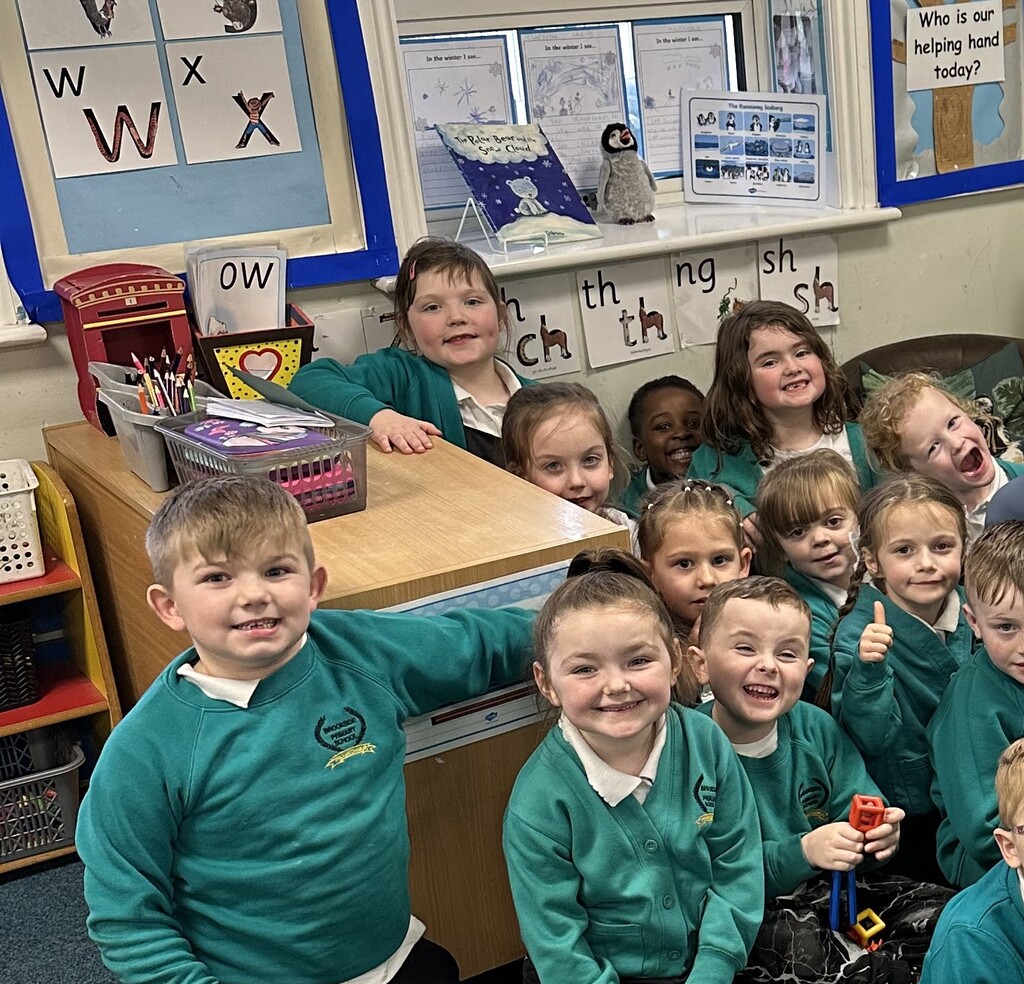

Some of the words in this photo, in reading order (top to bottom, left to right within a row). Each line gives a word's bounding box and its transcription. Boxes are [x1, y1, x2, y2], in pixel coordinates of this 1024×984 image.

[920, 10, 950, 28] Who
[957, 9, 967, 24] is
[973, 10, 994, 22] our
[914, 37, 962, 58] helping
[968, 30, 1000, 50] hand
[934, 60, 981, 81] today?
[469, 136, 490, 146] Polar
[494, 136, 515, 144] Bear
[478, 146, 501, 156] Snow
[506, 144, 531, 154] Cloud
[763, 238, 797, 274] sh
[219, 261, 274, 290] ow
[582, 270, 620, 309] th
[676, 258, 716, 294] ng
[619, 296, 668, 347] th
[516, 314, 572, 367] ch
